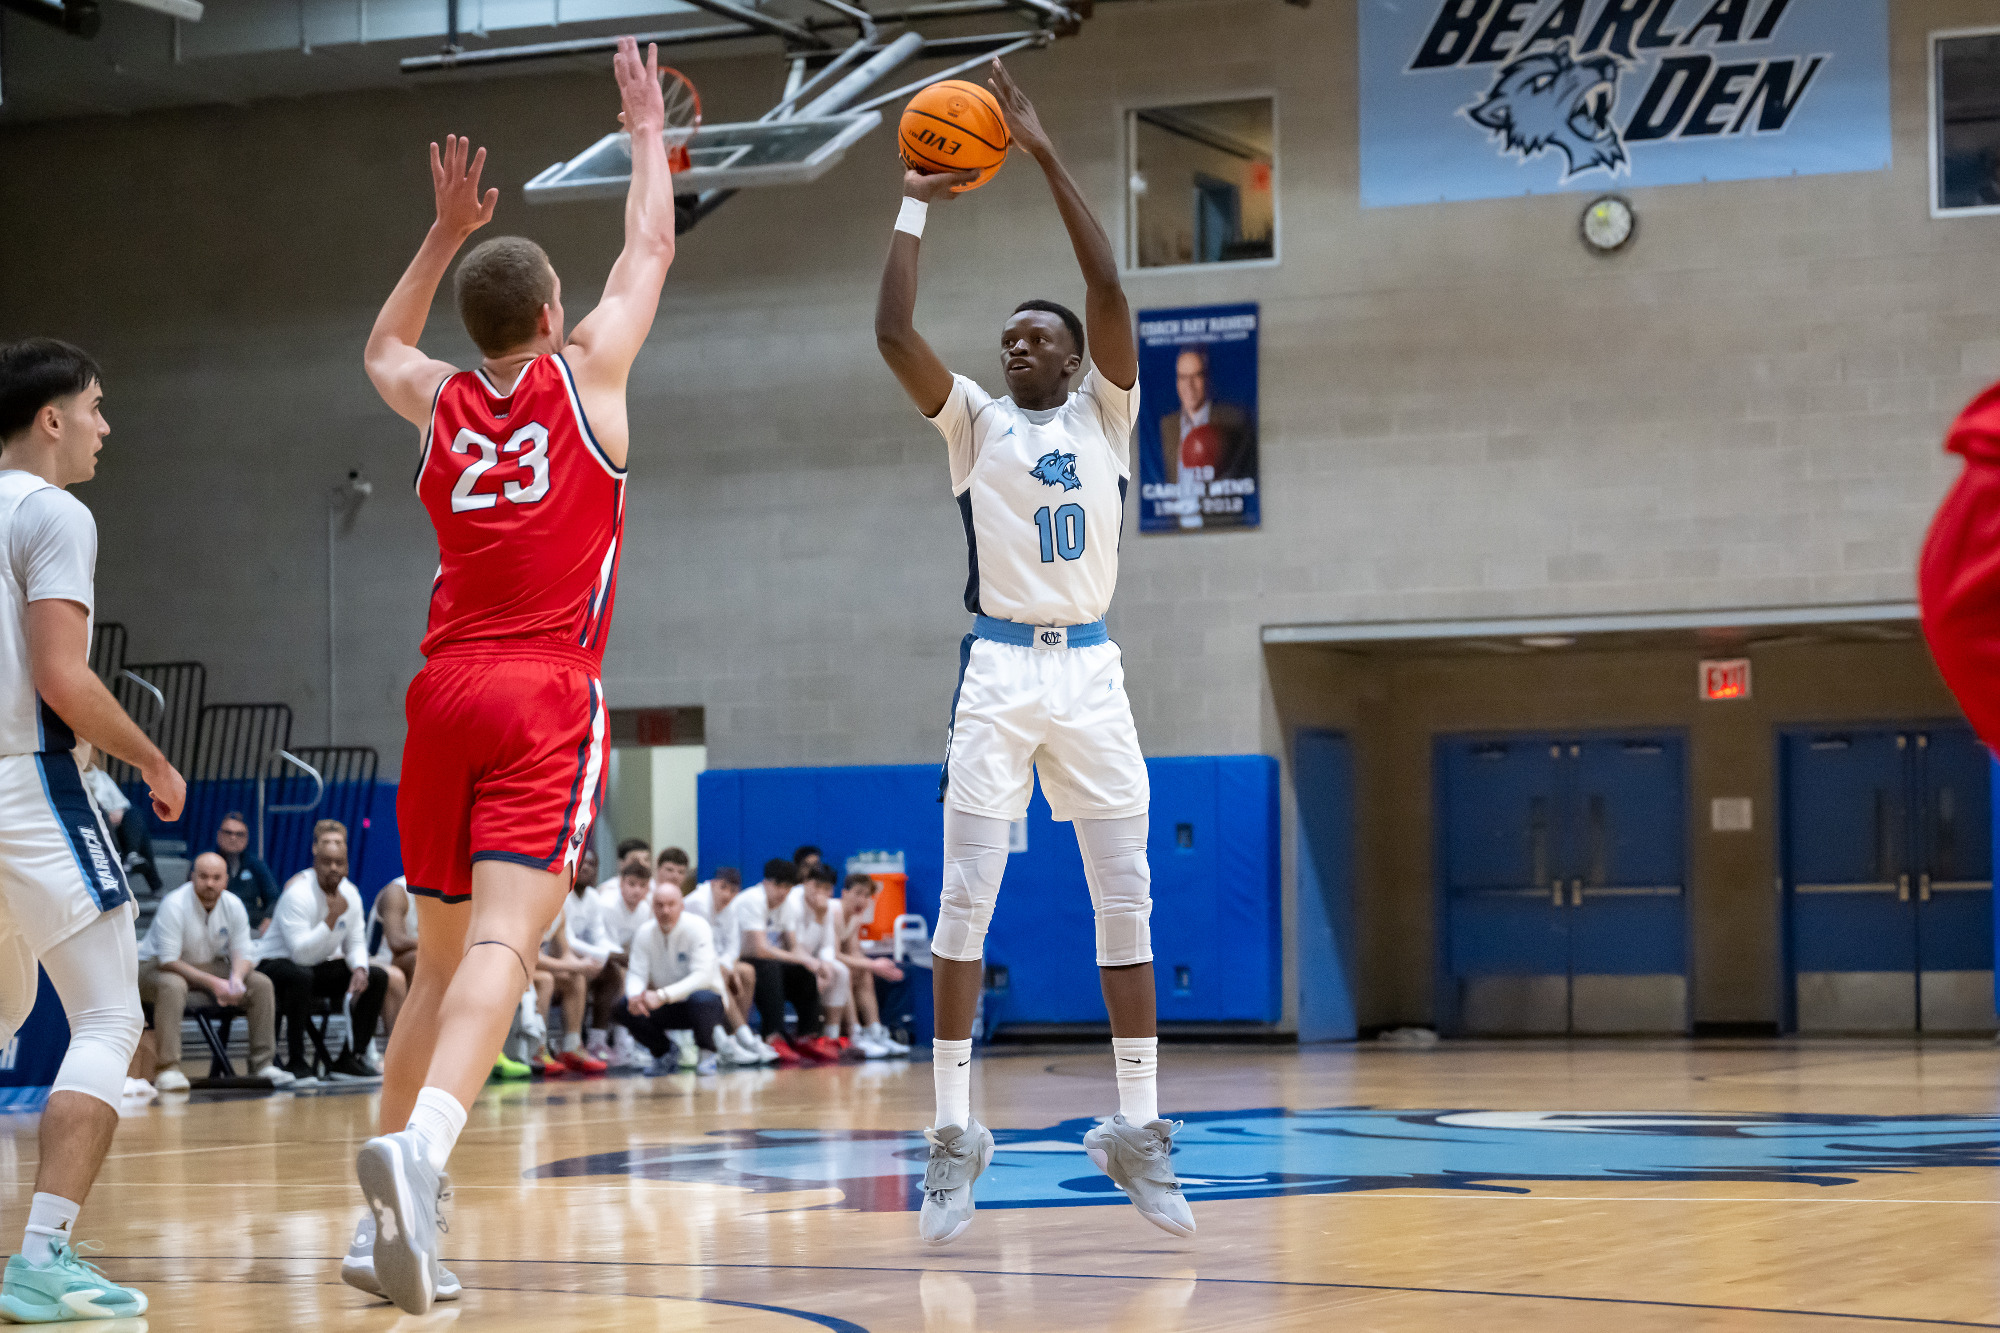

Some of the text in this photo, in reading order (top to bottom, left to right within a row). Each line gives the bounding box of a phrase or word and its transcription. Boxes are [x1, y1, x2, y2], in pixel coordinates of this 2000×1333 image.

[1621, 54, 1827, 142] DEN
[918, 129, 962, 155] EVO
[450, 420, 551, 514] 23
[1033, 502, 1086, 563] 10
[1707, 665, 1746, 699] EXIT
[78, 824, 120, 894] BARUCH
